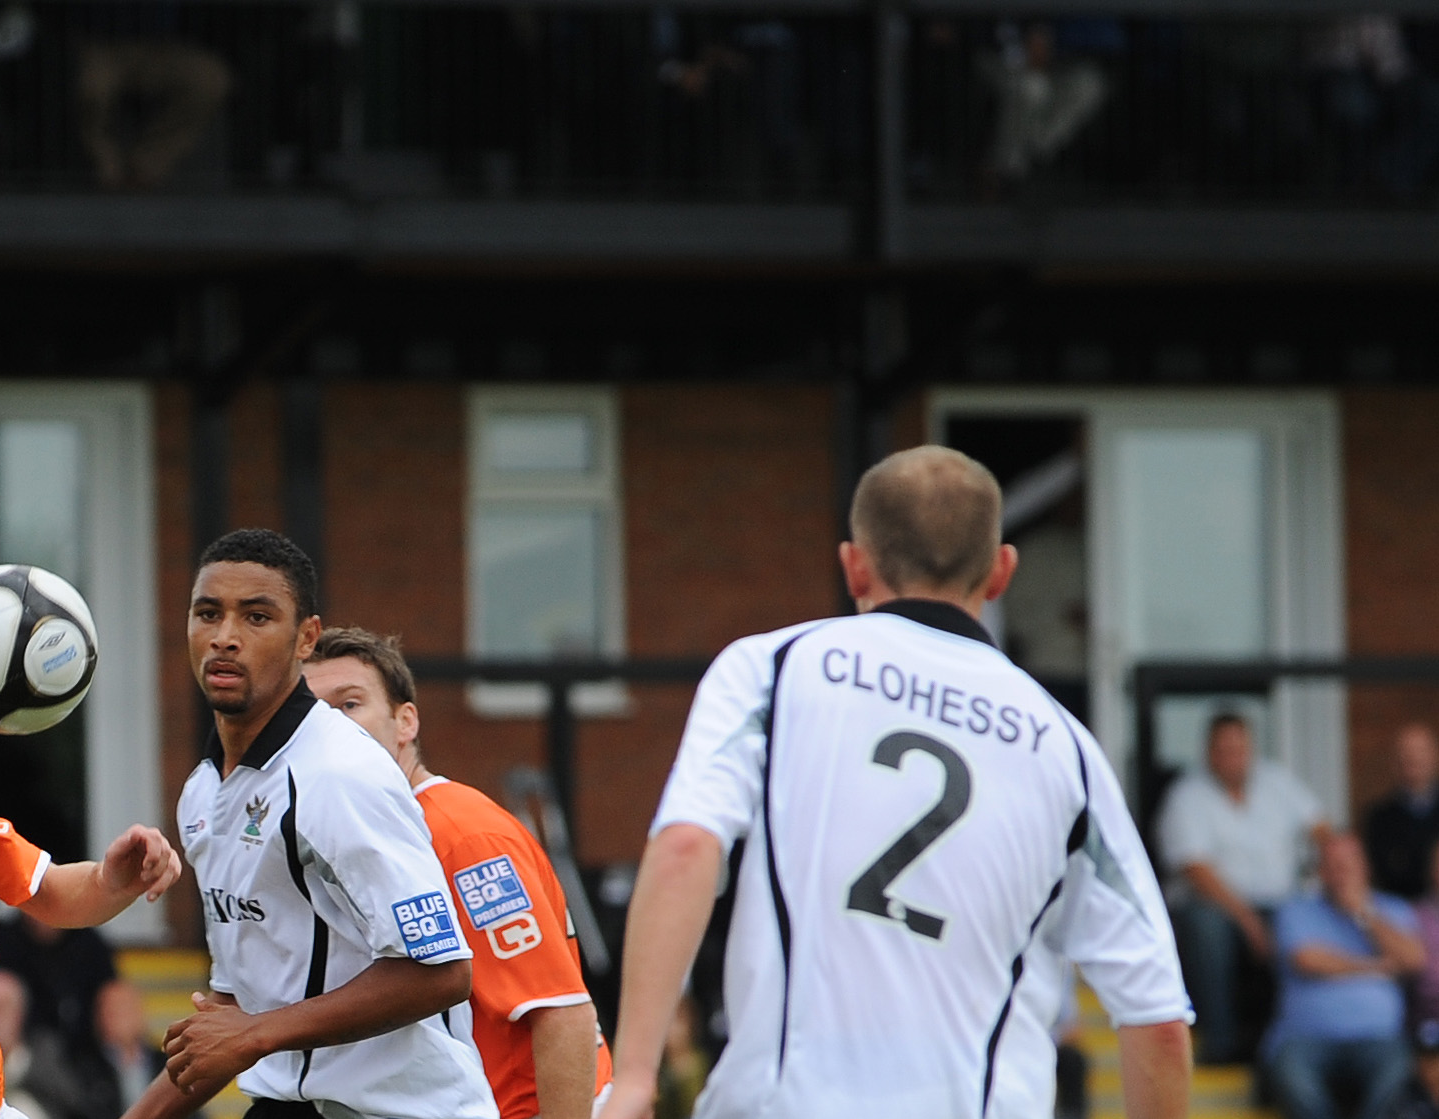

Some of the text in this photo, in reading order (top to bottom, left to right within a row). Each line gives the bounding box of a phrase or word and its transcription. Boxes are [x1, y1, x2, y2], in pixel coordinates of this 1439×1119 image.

[822, 648, 1051, 753] CLOHESSY
[845, 730, 972, 942] 2
[457, 860, 511, 892] BLUE
[395, 895, 447, 923] BLUE
[465, 883, 503, 910] SQ
[473, 897, 528, 925] PREMIER
[402, 916, 440, 943] SQ
[410, 937, 458, 959] PREMIER
